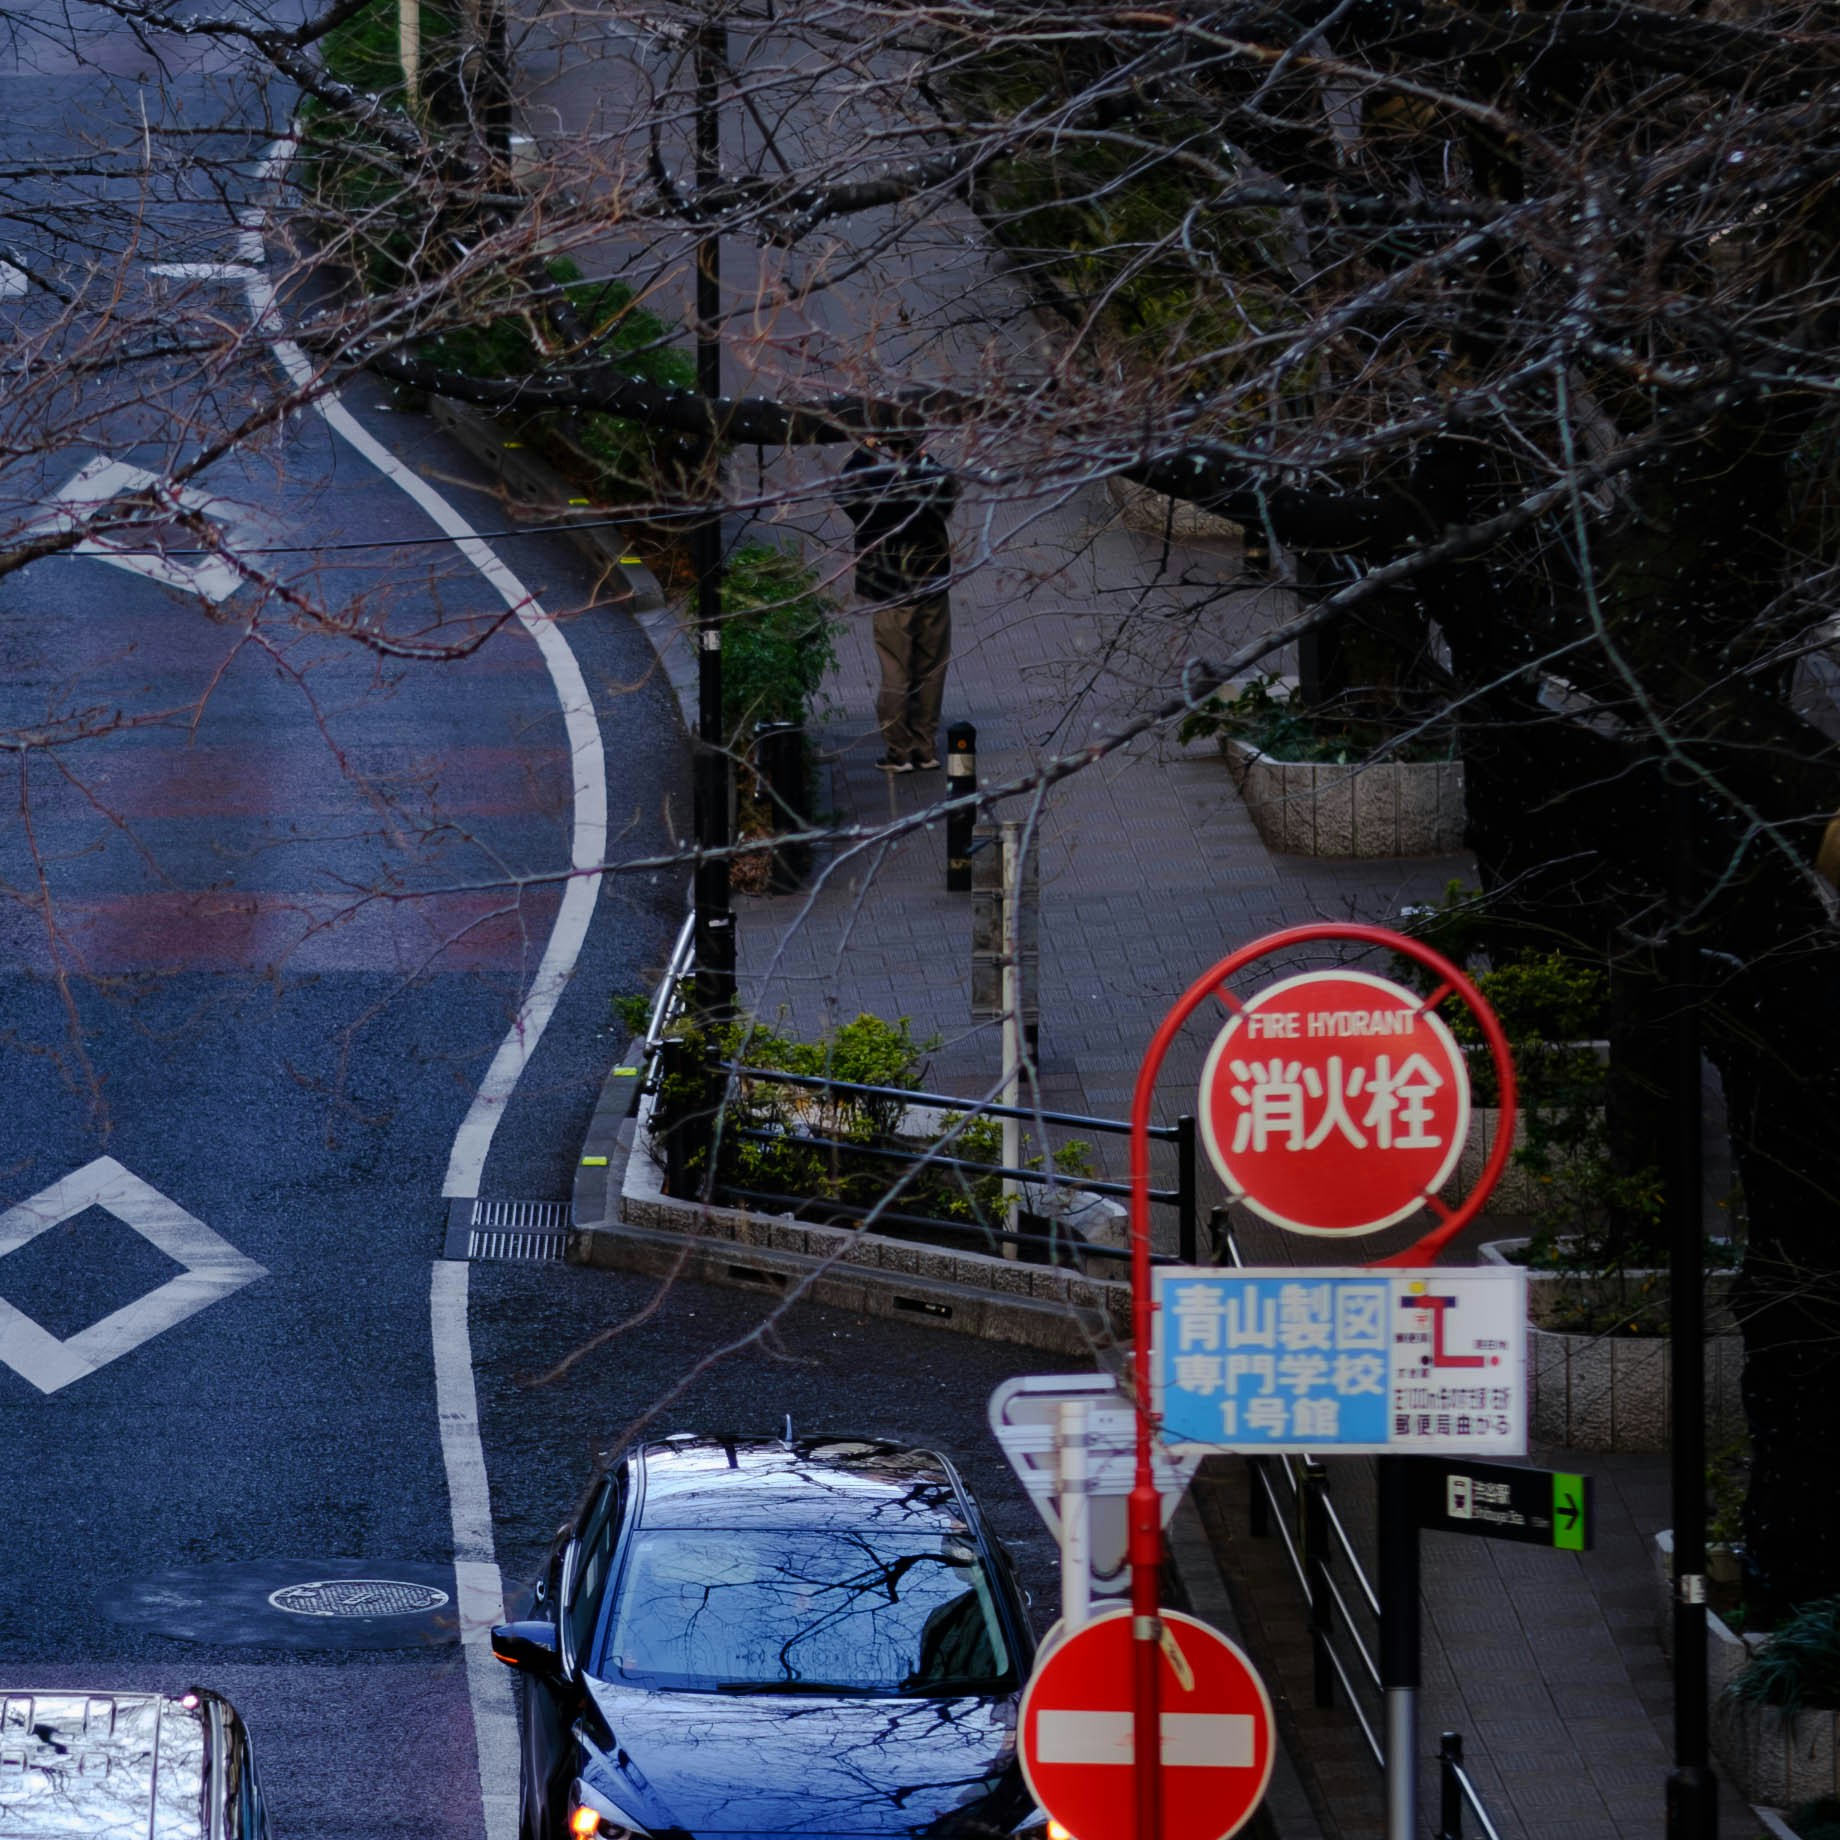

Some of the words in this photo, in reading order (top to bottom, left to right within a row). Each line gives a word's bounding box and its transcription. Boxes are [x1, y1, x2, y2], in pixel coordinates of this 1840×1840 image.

[1248, 1013, 1301, 1039] FIRE
[1307, 1009, 1416, 1037] HYDRANT
[1229, 1053, 1444, 1153] 消火栓
[1172, 1284, 1386, 1351] 青山製図
[1173, 1354, 1385, 1396] 専門学校
[1219, 1397, 1341, 1438] 1号館
